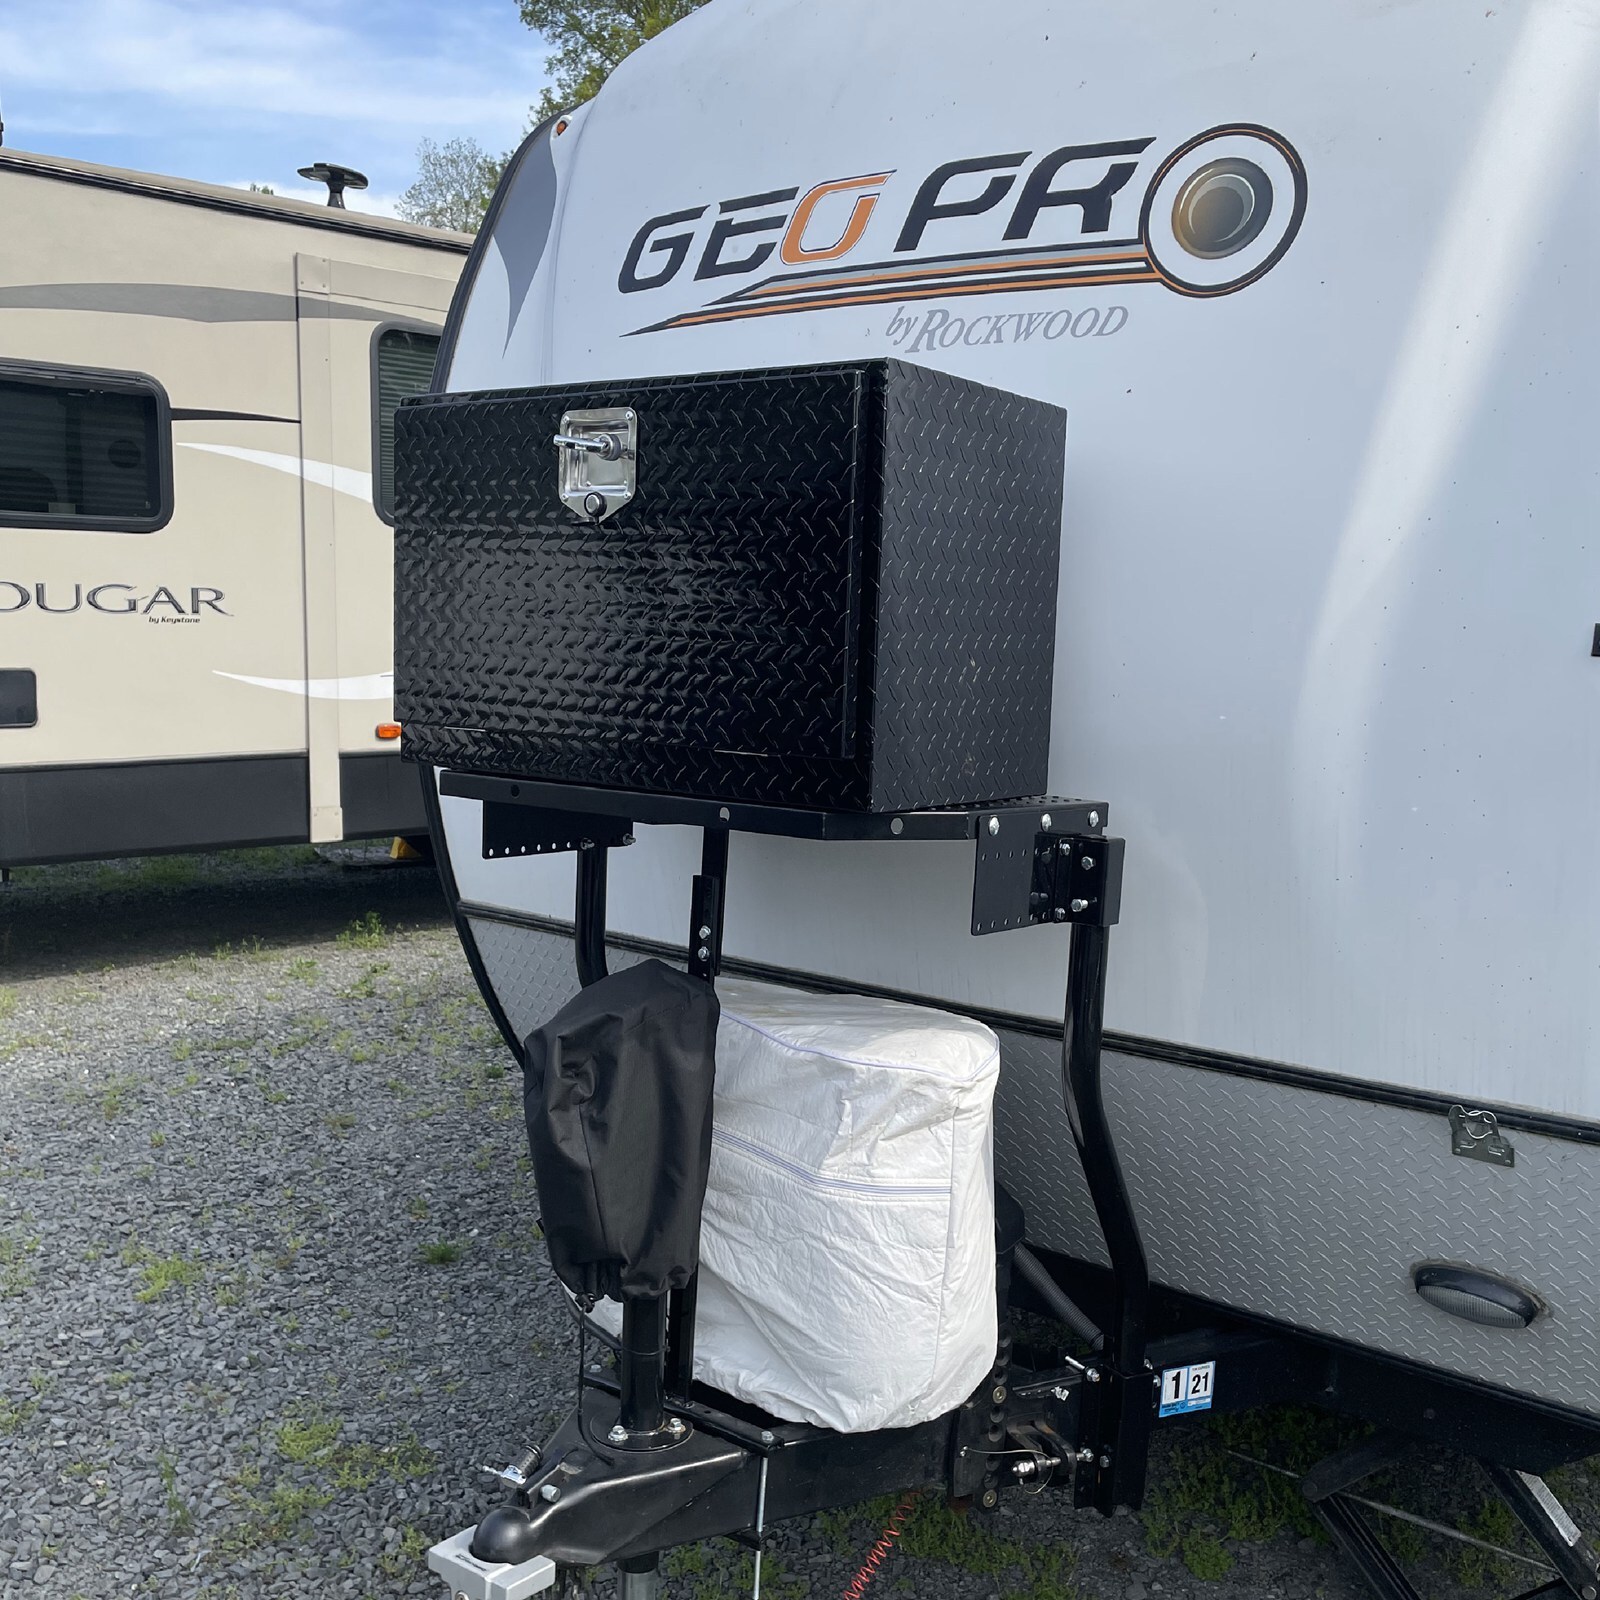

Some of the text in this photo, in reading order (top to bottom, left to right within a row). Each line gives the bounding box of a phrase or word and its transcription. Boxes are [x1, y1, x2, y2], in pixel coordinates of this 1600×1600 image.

[618, 122, 1308, 299] GEO PRO
[885, 306, 1129, 353] by ROCKWOOD
[0, 581, 234, 616] OUGAR
[149, 616, 201, 624] by Keystone
[1171, 1371, 1209, 1399] 1 21
